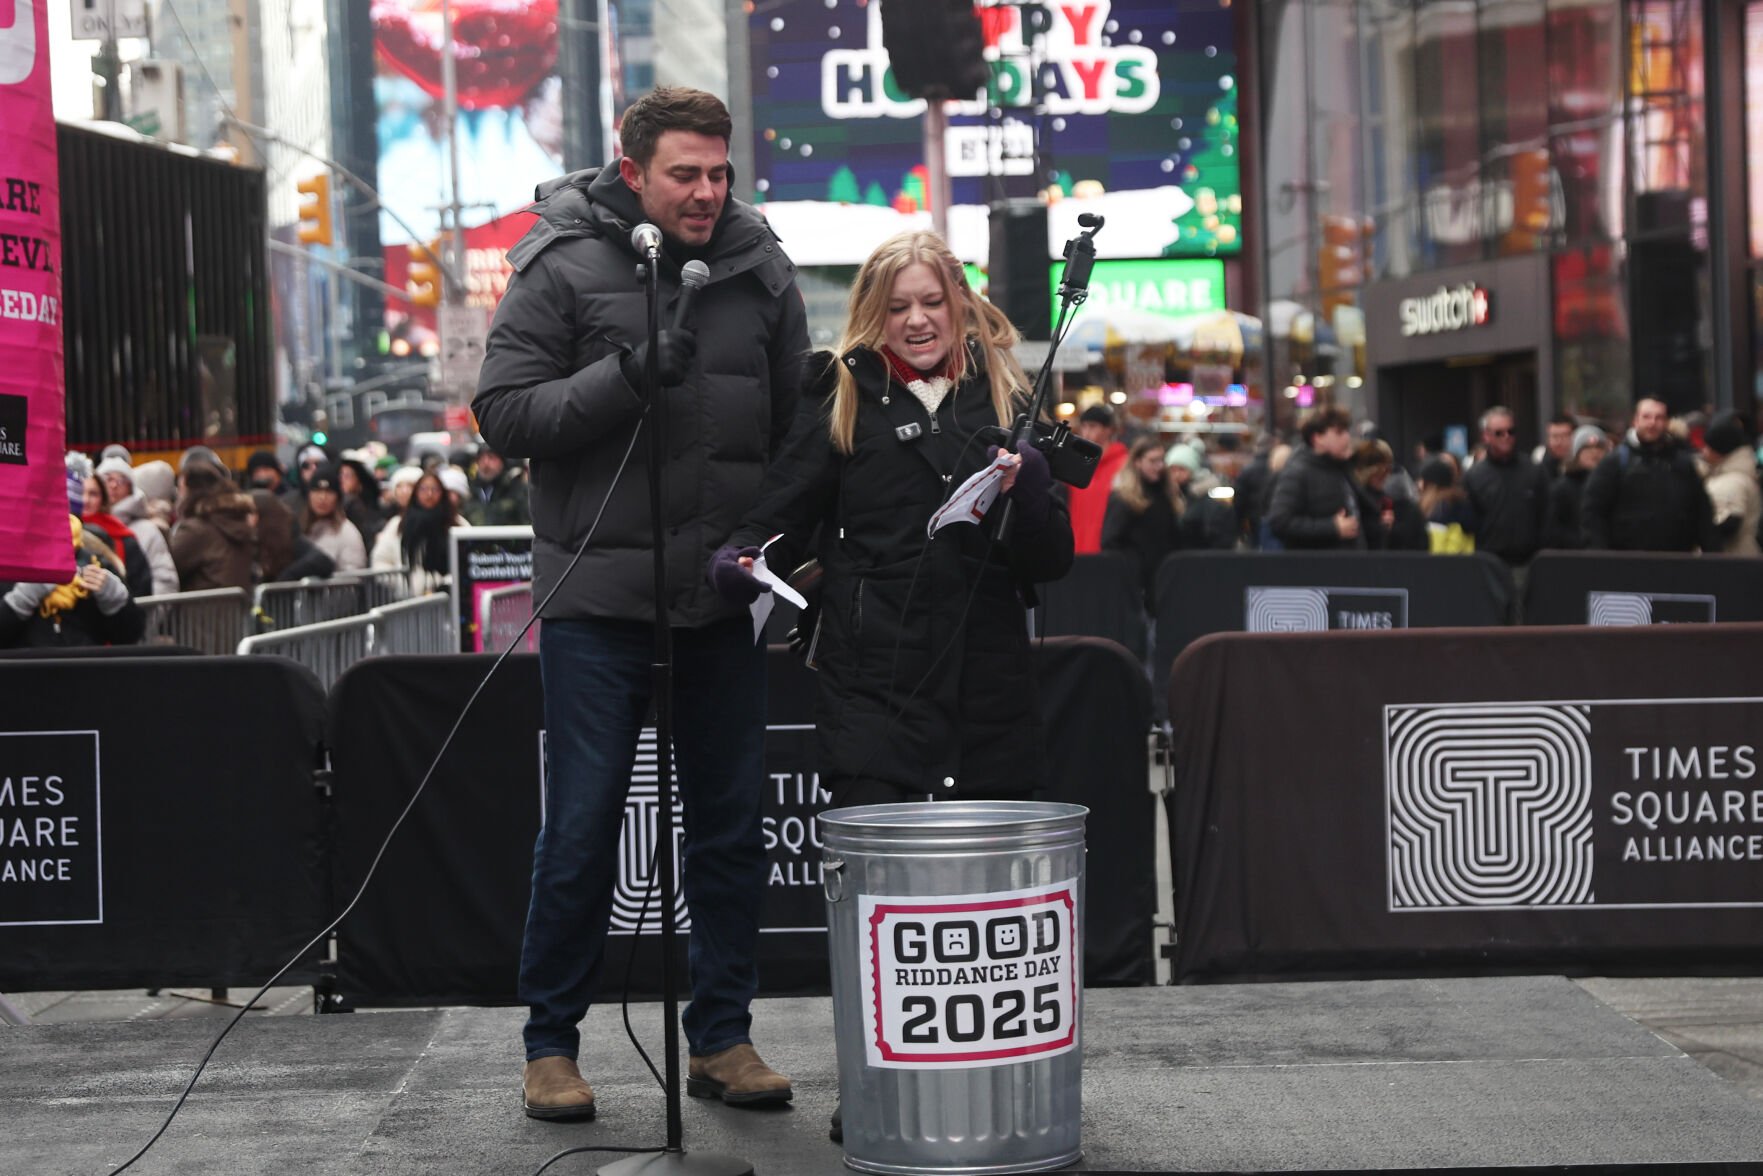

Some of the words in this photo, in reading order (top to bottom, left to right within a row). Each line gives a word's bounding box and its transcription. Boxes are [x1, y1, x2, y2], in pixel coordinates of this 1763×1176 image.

[836, 60, 1147, 104] HDAYS
[0, 178, 40, 215] RE
[0, 289, 57, 325] EDAY
[1087, 279, 1212, 310] QUARE
[1338, 611, 1392, 630] TIMES
[1624, 745, 1756, 780] TIMES
[769, 772, 833, 805] TIM
[1611, 791, 1763, 830] SQUARE
[0, 817, 79, 847] ARE
[762, 816, 824, 854] SQU
[1622, 835, 1763, 862] ALLIANCE
[768, 861, 824, 886] ALLI
[893, 910, 1060, 963] GOOD
[896, 963, 1018, 986] RIDDANCE
[1024, 956, 1061, 979] DAY
[902, 983, 1060, 1043] 2025
